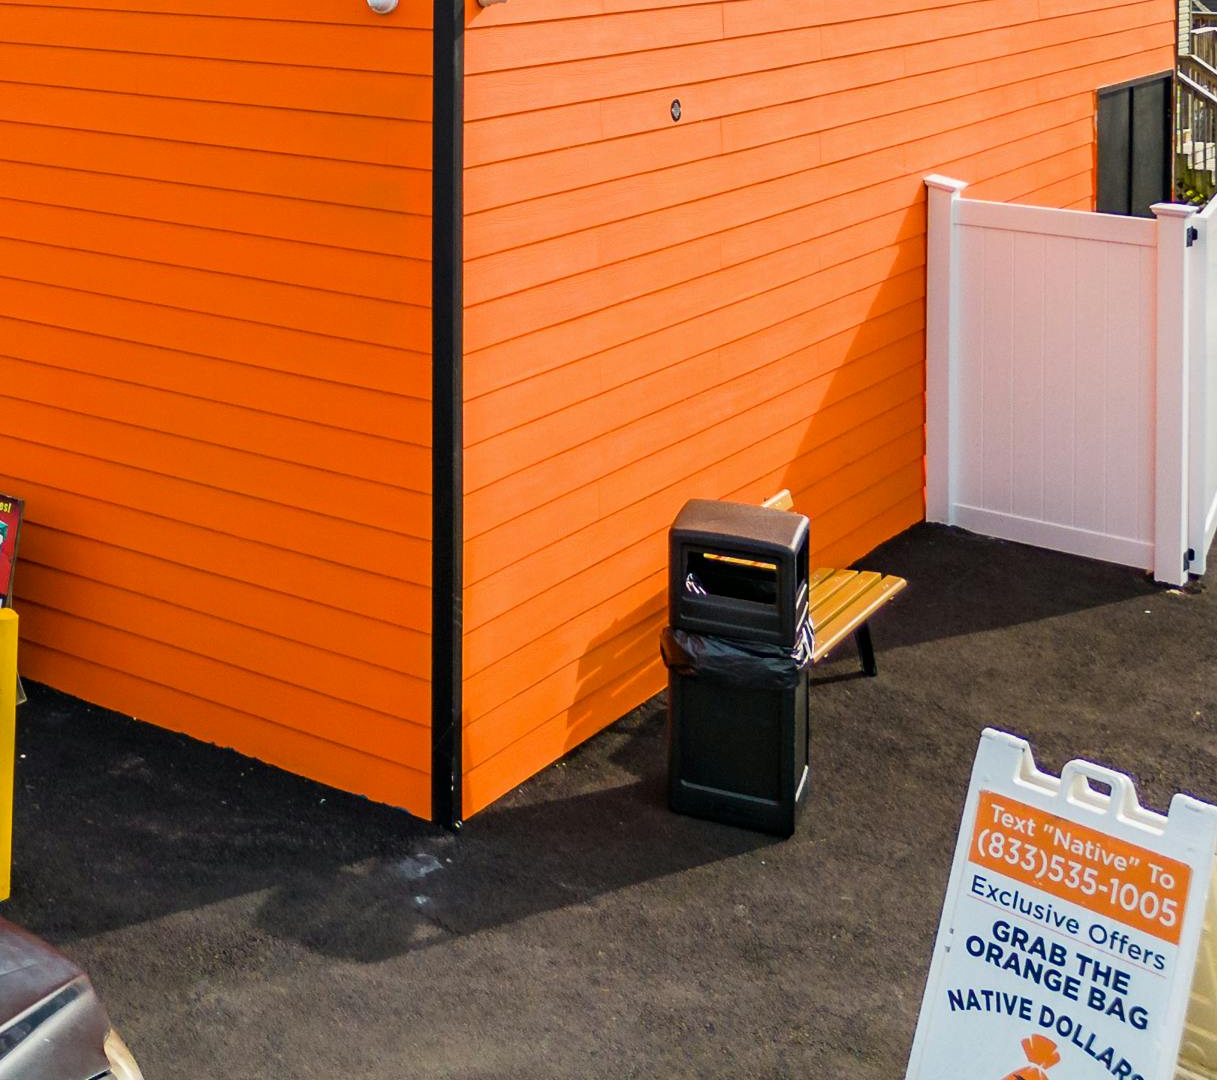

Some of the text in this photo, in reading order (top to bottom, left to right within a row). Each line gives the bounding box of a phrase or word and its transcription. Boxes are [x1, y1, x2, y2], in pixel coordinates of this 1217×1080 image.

[977, 828, 1178, 927] (833)535-1005
[991, 803, 1175, 890] Text "Native" To
[971, 874, 1166, 970] Exclusive Offers
[992, 920, 1132, 996] GRAB THE
[947, 989, 1033, 1021] NATIVE
[965, 935, 1149, 1031] ORANGE BAG
